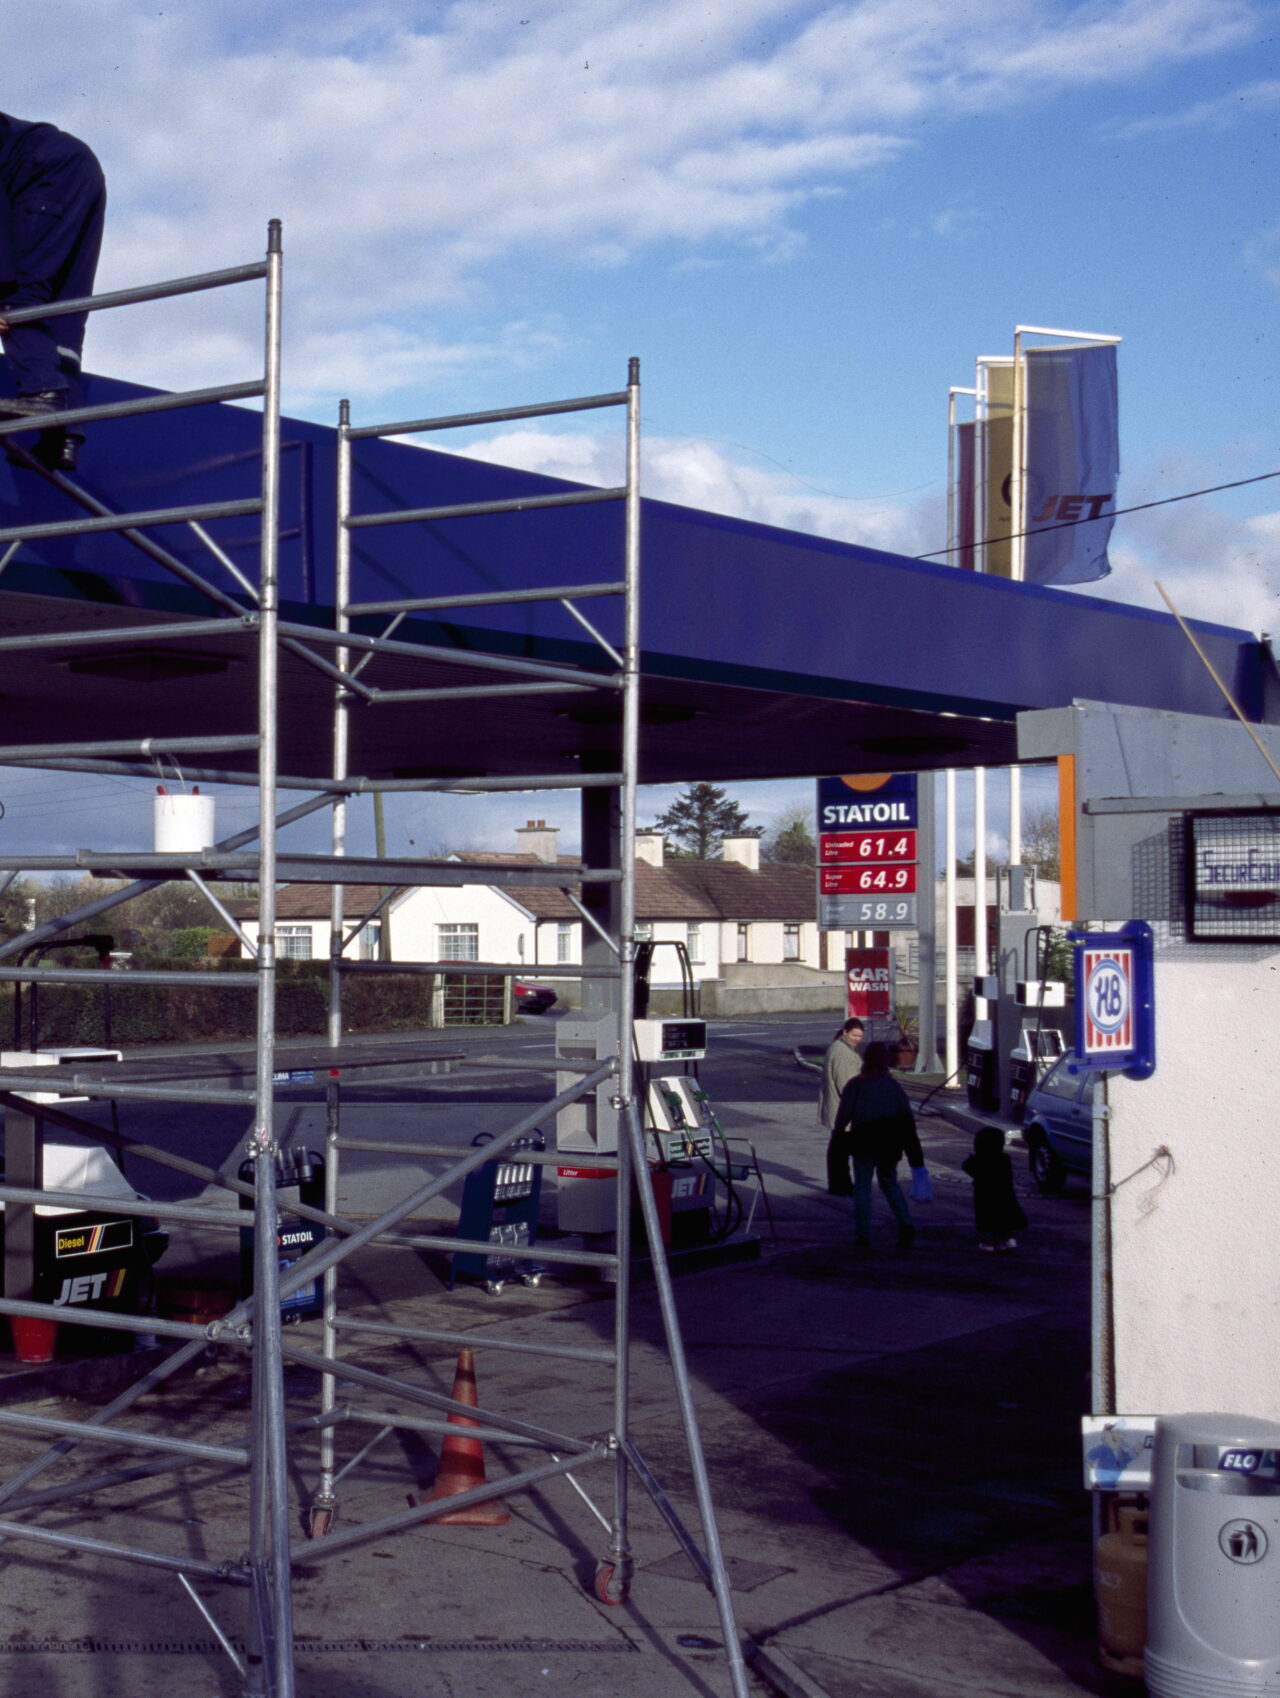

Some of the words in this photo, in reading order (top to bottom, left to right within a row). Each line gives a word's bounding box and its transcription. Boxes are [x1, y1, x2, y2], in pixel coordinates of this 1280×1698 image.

[1031, 494, 1112, 522] JET
[823, 803, 910, 824] STATOIL
[859, 837, 908, 857] 61.4
[859, 870, 908, 889] 64.9
[860, 903, 908, 920] 58.9
[848, 967, 889, 981] CAR
[849, 982, 889, 992] WASH
[1095, 973, 1122, 1018] HB
[671, 1176, 697, 1198] JET
[58, 1235, 85, 1249] Diesel
[282, 1230, 314, 1246] STATOIL
[54, 1273, 108, 1306] JET
